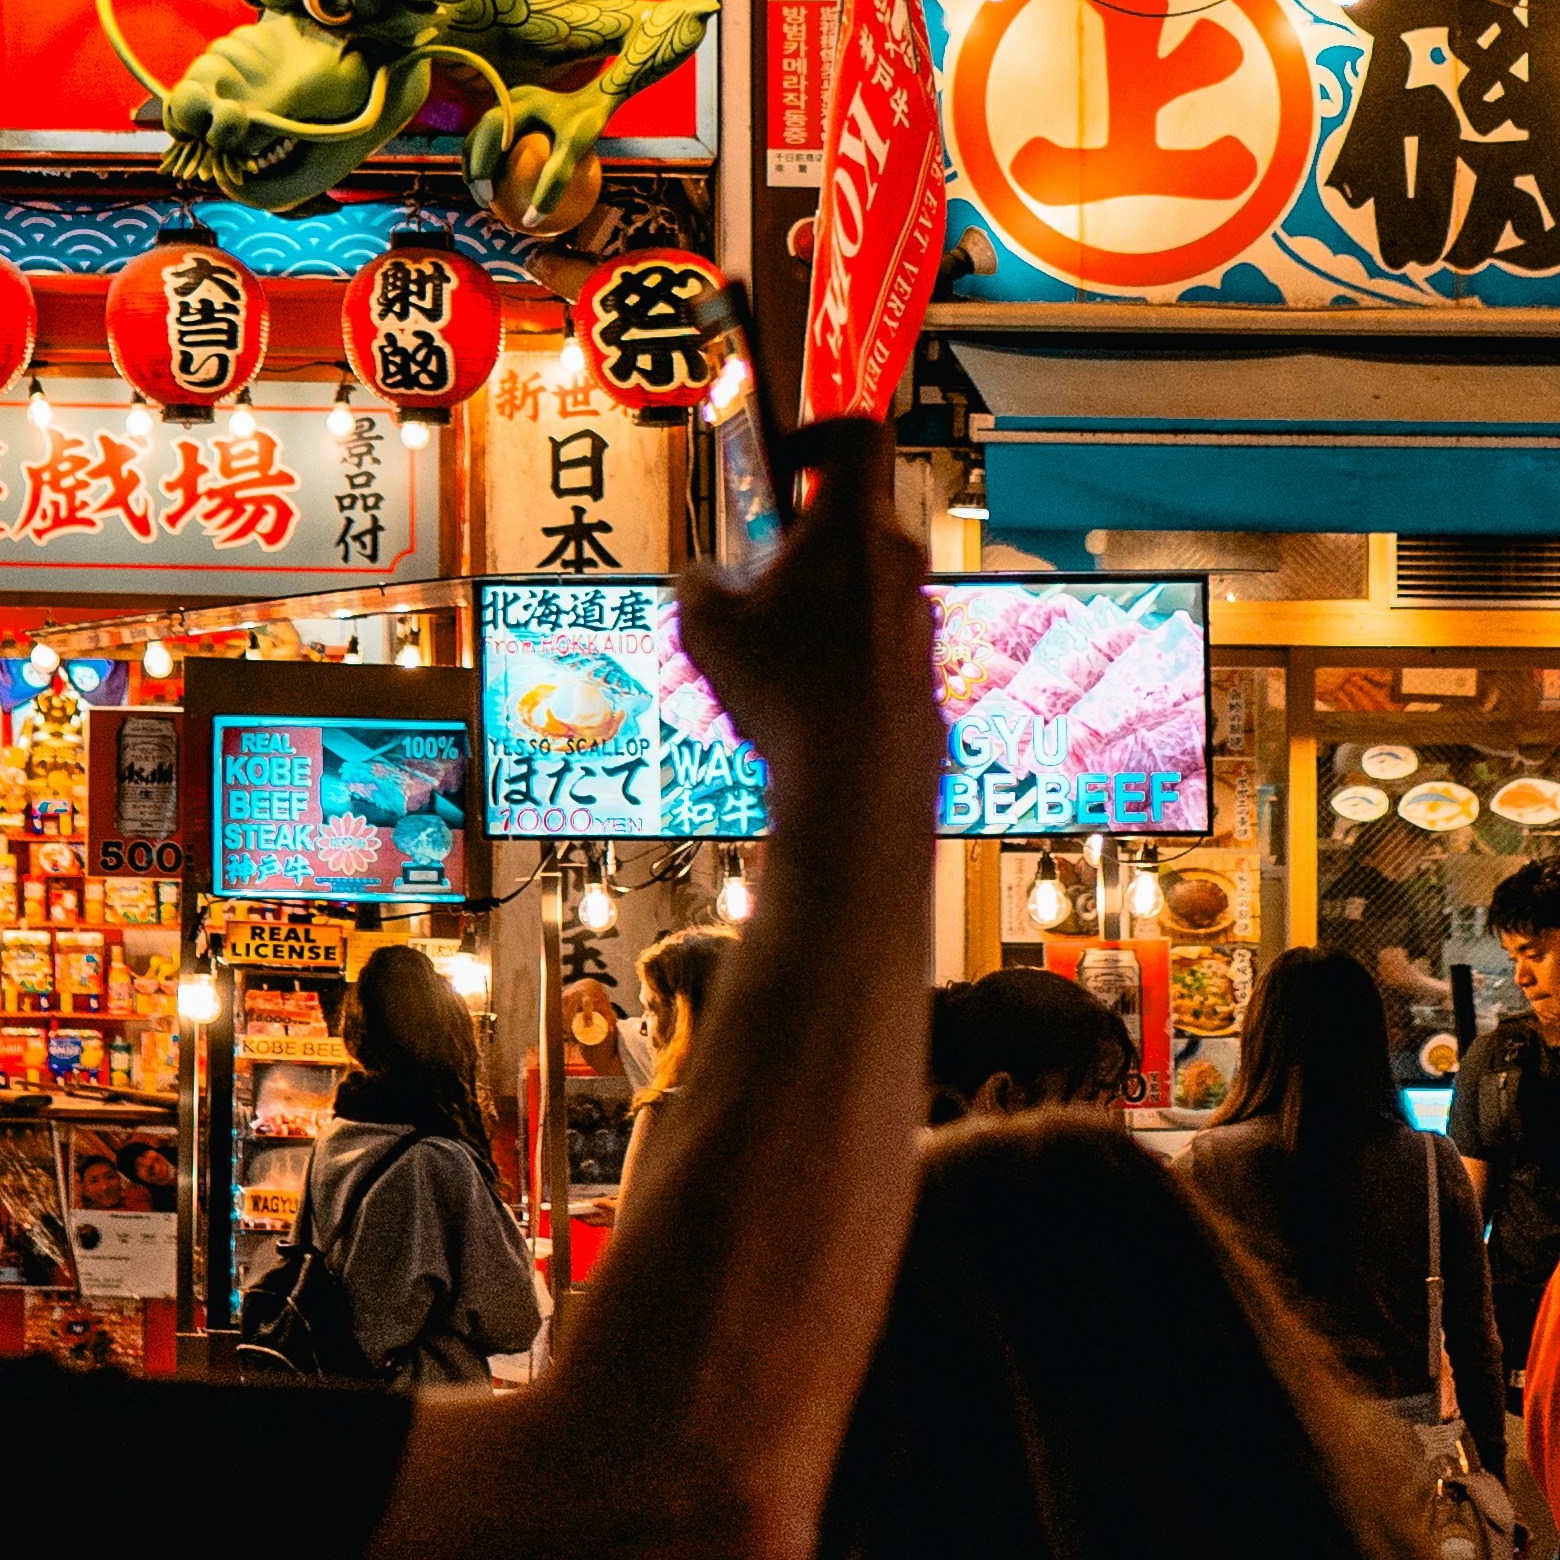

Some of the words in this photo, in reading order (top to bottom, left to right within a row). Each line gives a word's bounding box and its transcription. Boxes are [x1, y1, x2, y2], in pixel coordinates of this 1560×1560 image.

[169, 255, 242, 389] 大当り
[594, 265, 716, 389] 祭
[496, 369, 630, 422] 新世
[334, 416, 386, 565] 景品付
[482, 589, 654, 632] 北海道産
[541, 634, 655, 656] HOKKAIDO
[241, 732, 296, 755] REAL
[402, 735, 459, 760] 100%
[489, 738, 551, 756] YESSO
[566, 738, 651, 757] SCALLOP
[224, 755, 313, 787] KOBE
[490, 756, 650, 807] ほたて
[228, 789, 310, 821] BEEF
[672, 790, 760, 835] 和牛
[1034, 771, 1182, 825] BEEF
[499, 806, 592, 833] 1000
[594, 817, 643, 833] YEN
[224, 823, 316, 852] STEAK
[100, 840, 183, 873] 500
[224, 854, 315, 886] 神戸牛
[250, 925, 318, 943] REAL
[231, 942, 337, 961] LICENSE
[242, 1040, 297, 1055] KOBE
